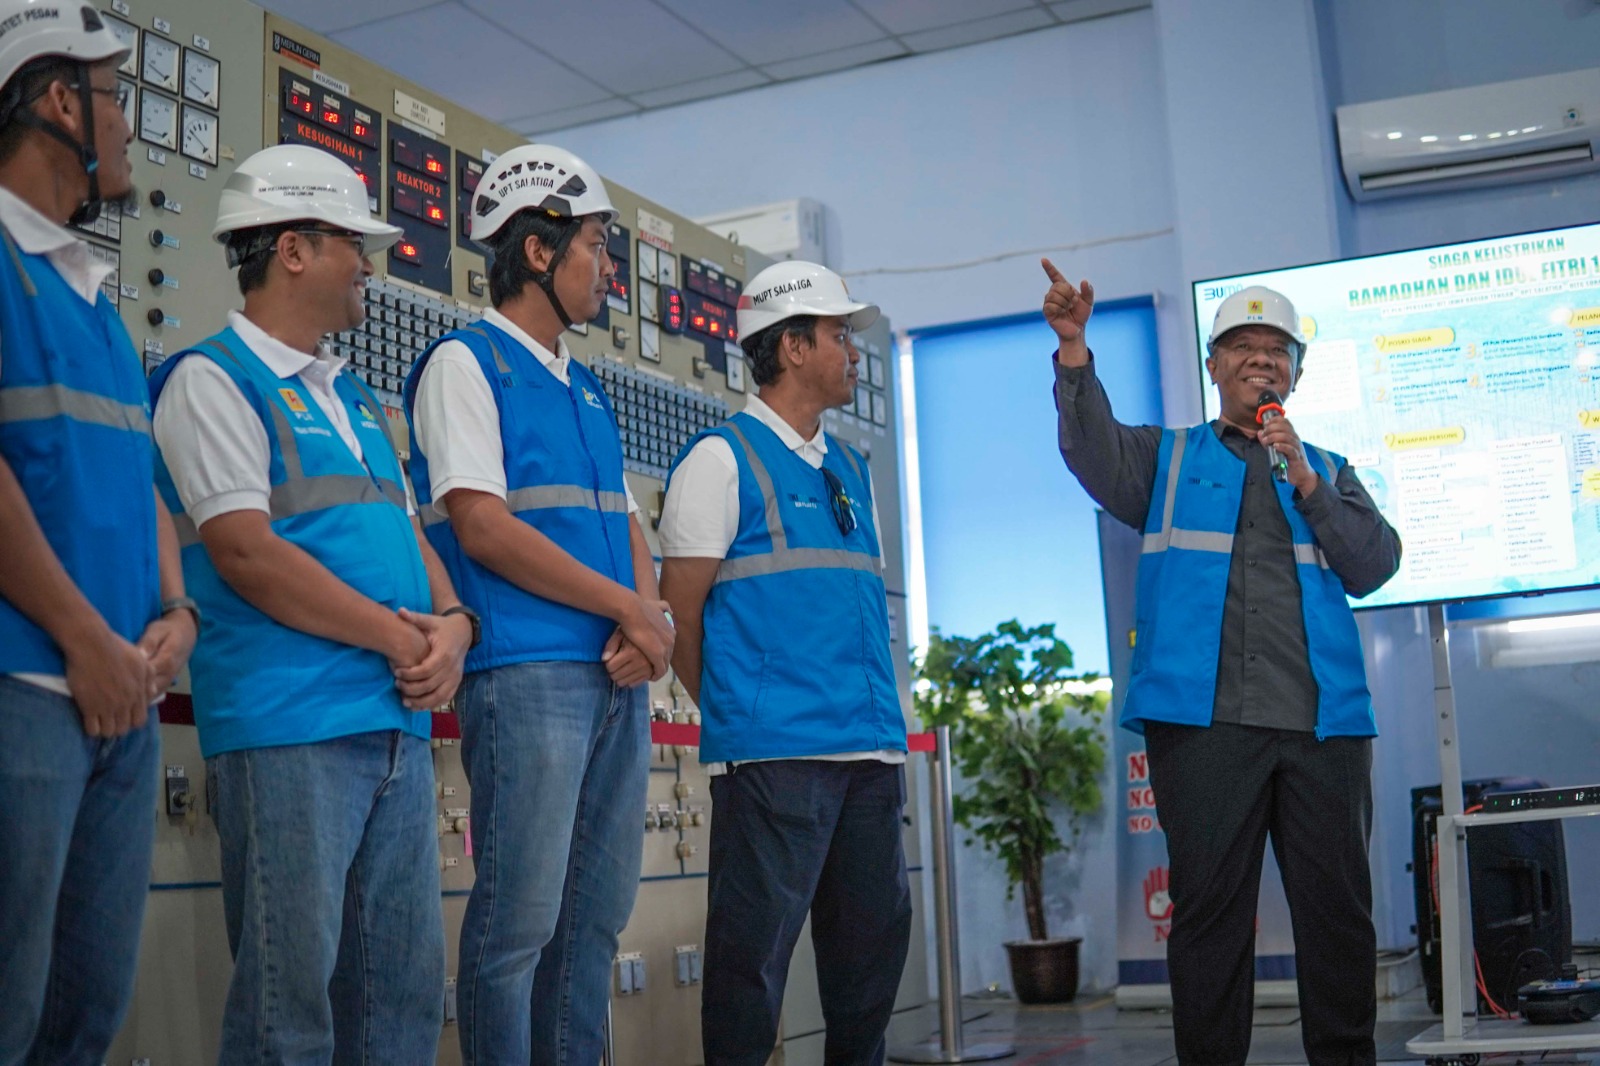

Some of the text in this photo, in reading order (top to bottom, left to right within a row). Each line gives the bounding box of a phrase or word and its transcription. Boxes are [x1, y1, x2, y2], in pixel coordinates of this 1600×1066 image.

[297, 123, 364, 161] KESUGIHAN 1
[396, 170, 442, 199] REAKTOR 2
[498, 183, 514, 199] UPT
[1428, 236, 1566, 270] SIAGA KELISTRIKAN
[1348, 276, 1450, 308] RAMADHAN
[1453, 270, 1491, 293] DAN
[1540, 256, 1587, 281] FITRI
[752, 289, 773, 307] MUPT
[1411, 335, 1432, 344] SIAGA
